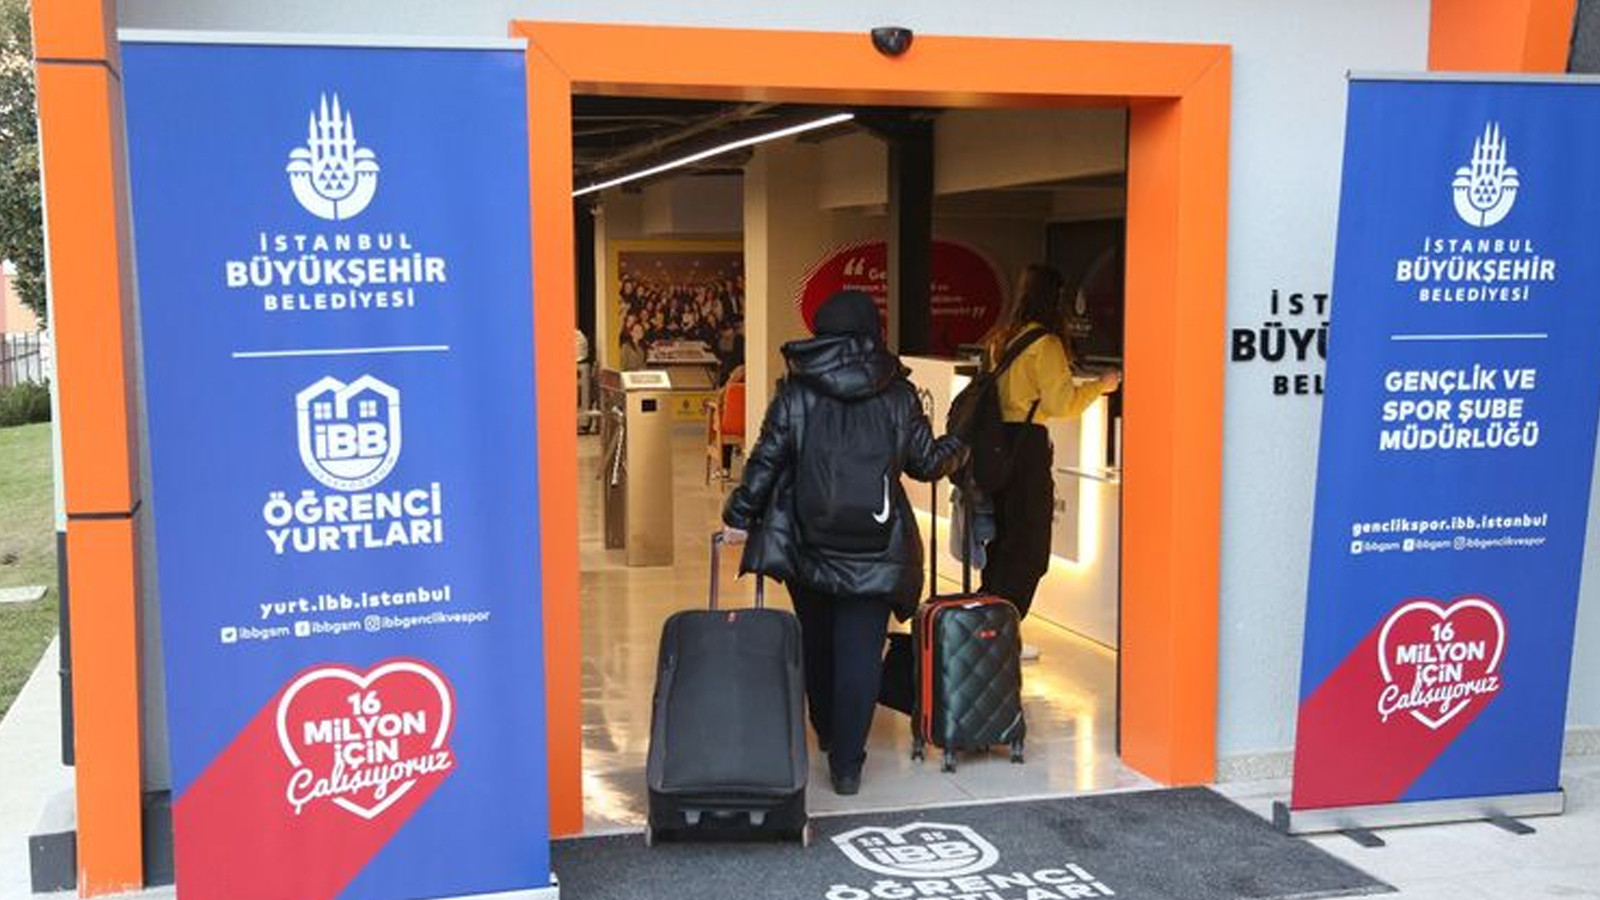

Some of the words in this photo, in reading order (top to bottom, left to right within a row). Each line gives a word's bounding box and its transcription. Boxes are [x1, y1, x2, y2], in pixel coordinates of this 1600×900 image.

[261, 232, 411, 251] İSTANBUL
[1424, 238, 1533, 253] İSTANBUL
[227, 252, 447, 288] BÜYÜKŞEHİR
[1396, 256, 1555, 283] BÜYÜKŞEHİR
[264, 288, 414, 310] BELEDİYESİ
[1419, 286, 1529, 302] BELEDİYESİ
[1385, 365, 1497, 394] GENÇLİK
[1503, 369, 1536, 391] VE
[1382, 400, 1452, 421] SPOR
[1457, 398, 1523, 422] ŞUBE
[1380, 422, 1539, 450] MÜDÜRLÜĞÜ
[263, 481, 442, 525] ÖĞRENCİ
[265, 519, 443, 555] YURTLARI
[1352, 513, 1548, 536] genclikspor.ibb.istanbul
[260, 585, 451, 619] yurt.ibb.istanbul
[1431, 621, 1454, 641] 16
[347, 690, 381, 715] 16
[1377, 675, 1499, 723] Çalışıyoruz
[286, 750, 452, 814] Çalışıyoruz
[825, 863, 1097, 900] ÖĞRENCİ
